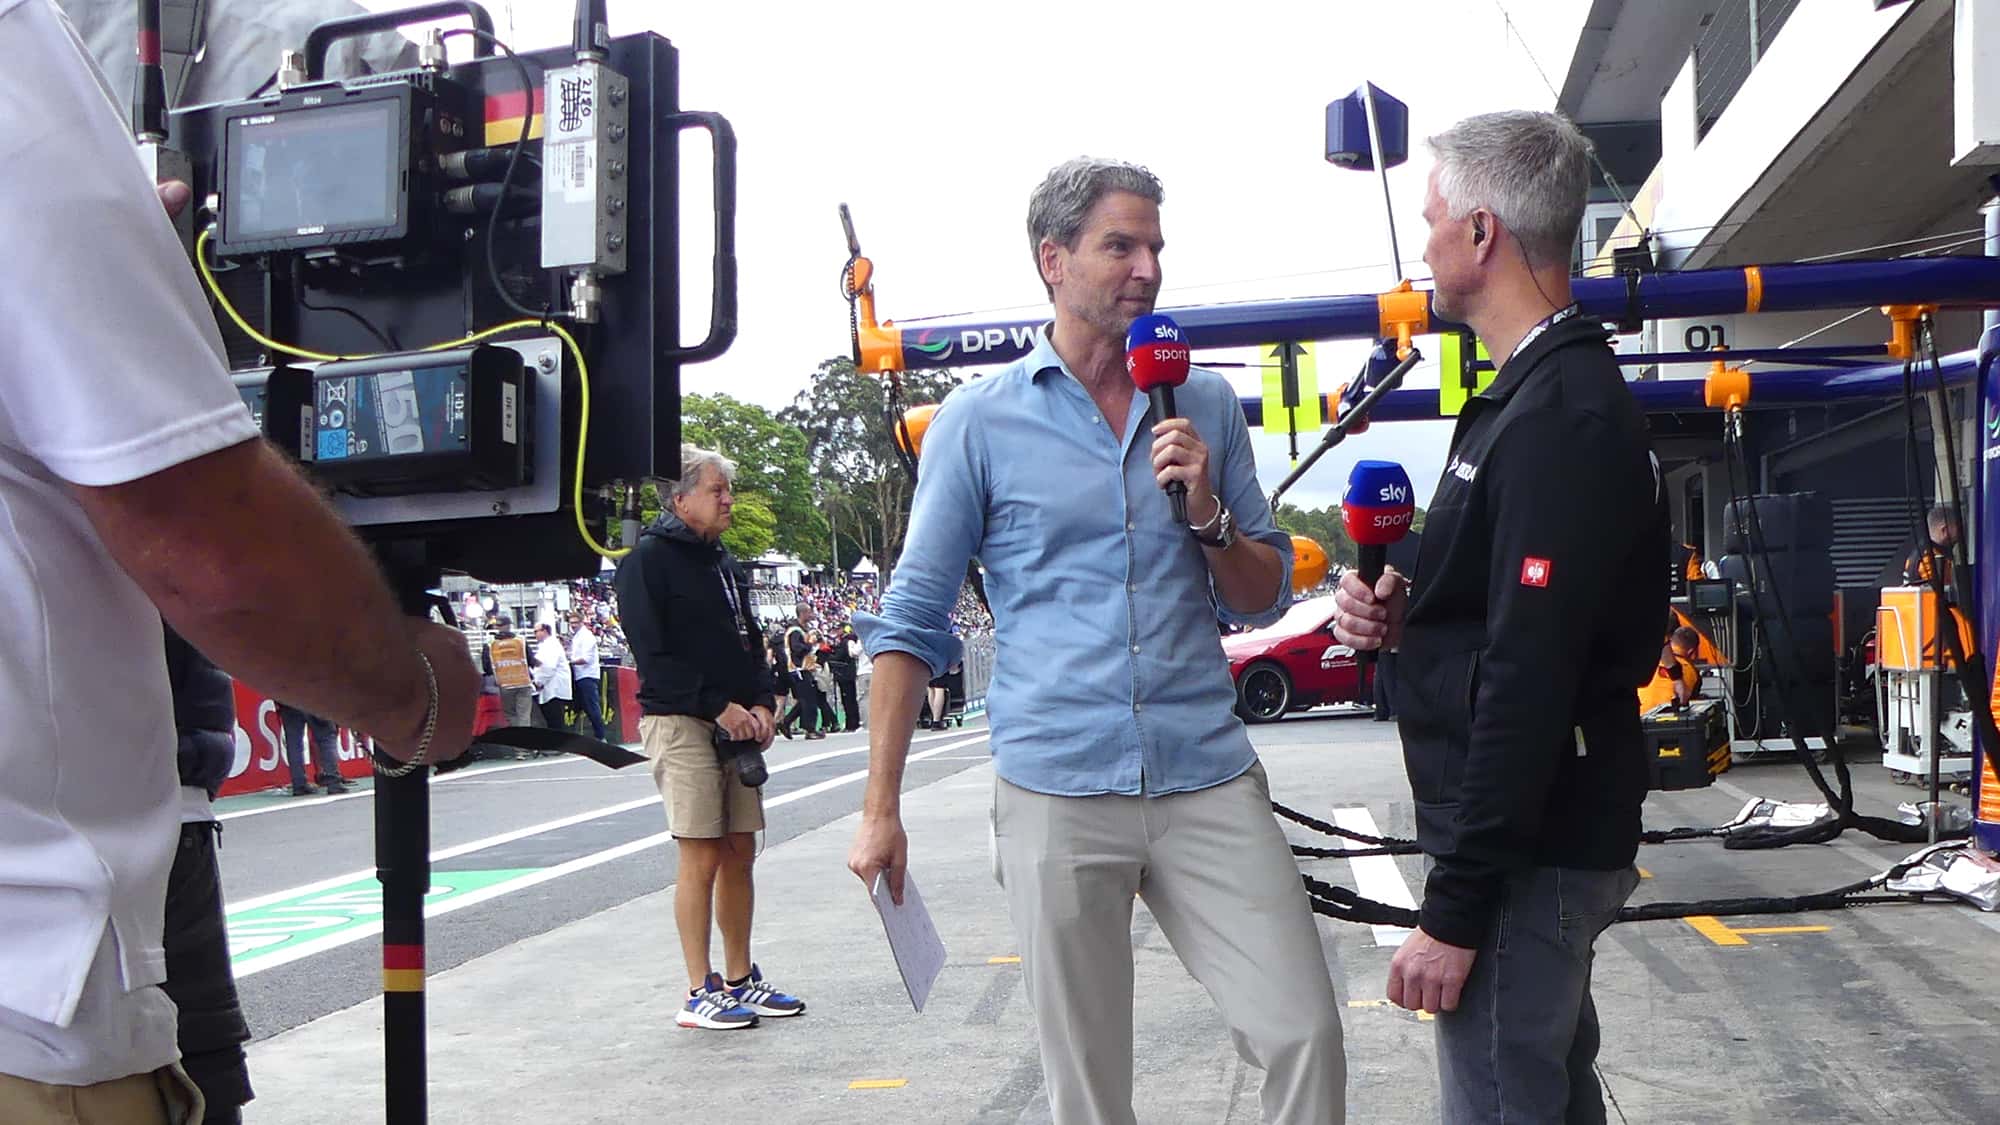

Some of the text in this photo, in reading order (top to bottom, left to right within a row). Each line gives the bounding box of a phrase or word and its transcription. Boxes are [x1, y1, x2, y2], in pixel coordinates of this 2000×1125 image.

[960, 330, 1006, 353] DP
[1154, 324, 1179, 340] sky
[1684, 325, 1731, 351] 01
[1153, 347, 1188, 363] sport
[1379, 483, 1407, 503] sky
[1373, 510, 1413, 529] sport
